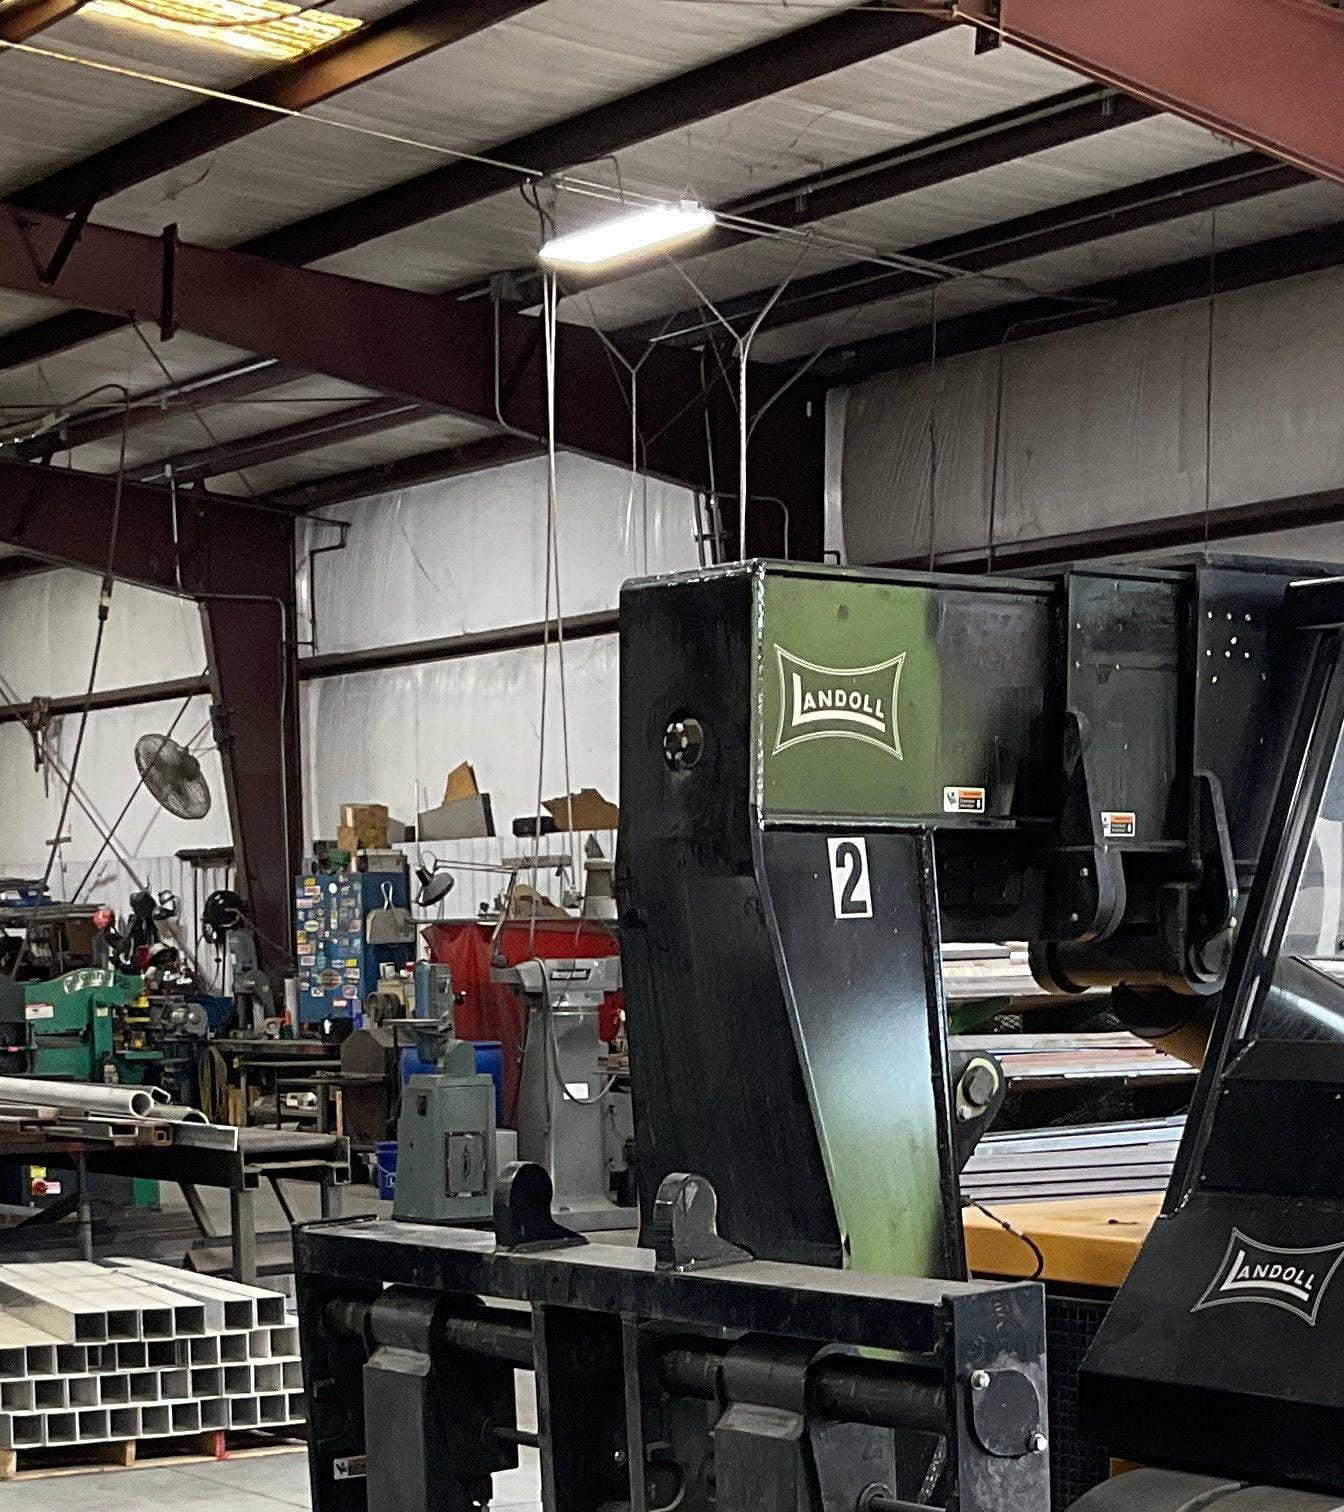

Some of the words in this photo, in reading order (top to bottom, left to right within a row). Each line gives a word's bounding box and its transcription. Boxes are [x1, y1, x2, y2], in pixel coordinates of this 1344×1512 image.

[792, 672, 886, 733] LANDOLL
[836, 841, 867, 914] 2
[1219, 1249, 1315, 1302] LANDOLL
